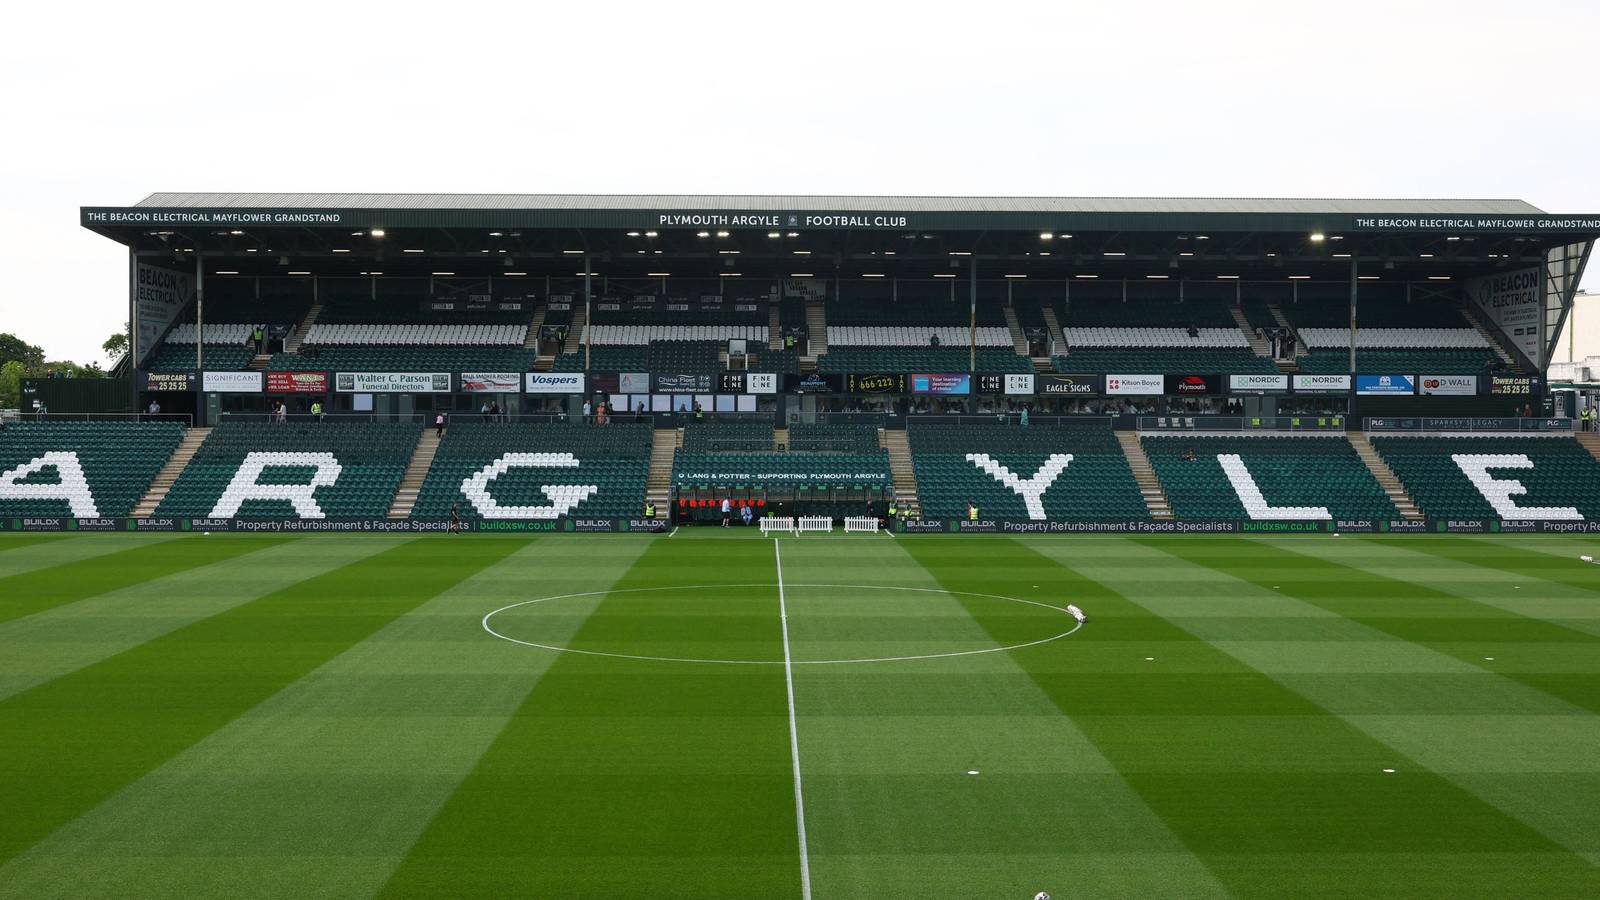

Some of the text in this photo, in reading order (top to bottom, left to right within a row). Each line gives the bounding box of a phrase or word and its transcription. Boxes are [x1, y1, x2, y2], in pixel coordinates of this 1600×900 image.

[87, 212, 340, 222] THE BEACON ELECTRICAL MAYFLOWER GRANDSTAND
[659, 215, 779, 226] PLYMOUTH ARGYLE
[806, 216, 907, 226] FOOTBALL CLUB
[1357, 218, 1600, 229] THE BEACON ELECTRICAL MAYFLOWER GRANDSTAND
[140, 268, 177, 290] BEACON
[1493, 271, 1537, 293] BEACON
[140, 286, 177, 305] ELECTRICAL
[1493, 291, 1537, 308] ELECTRICAL
[148, 373, 170, 381] TOWER
[532, 375, 578, 385] Vospers
[1491, 376, 1514, 385] TOWER
[159, 382, 167, 390] 25
[168, 382, 177, 390] 25
[178, 382, 187, 390] 25
[1046, 384, 1091, 393] EAGLE SIGNS
[1141, 379, 1161, 388] Boyce
[1178, 382, 1206, 391] Plymouth
[1502, 385, 1511, 394] 25
[1511, 385, 1521, 394] 25
[1521, 385, 1530, 394] 25
[236, 520, 282, 531] Property
[284, 520, 361, 529] Refurbishment
[363, 520, 372, 529] &
[373, 520, 410, 532] Façade
[480, 521, 556, 530] buildxsw.co.uk
[1004, 521, 1233, 533] Property Refurbishment & Façade Specialists
[1243, 521, 1318, 531] buildxsw.co.uk
[1543, 521, 1588, 532] Property
